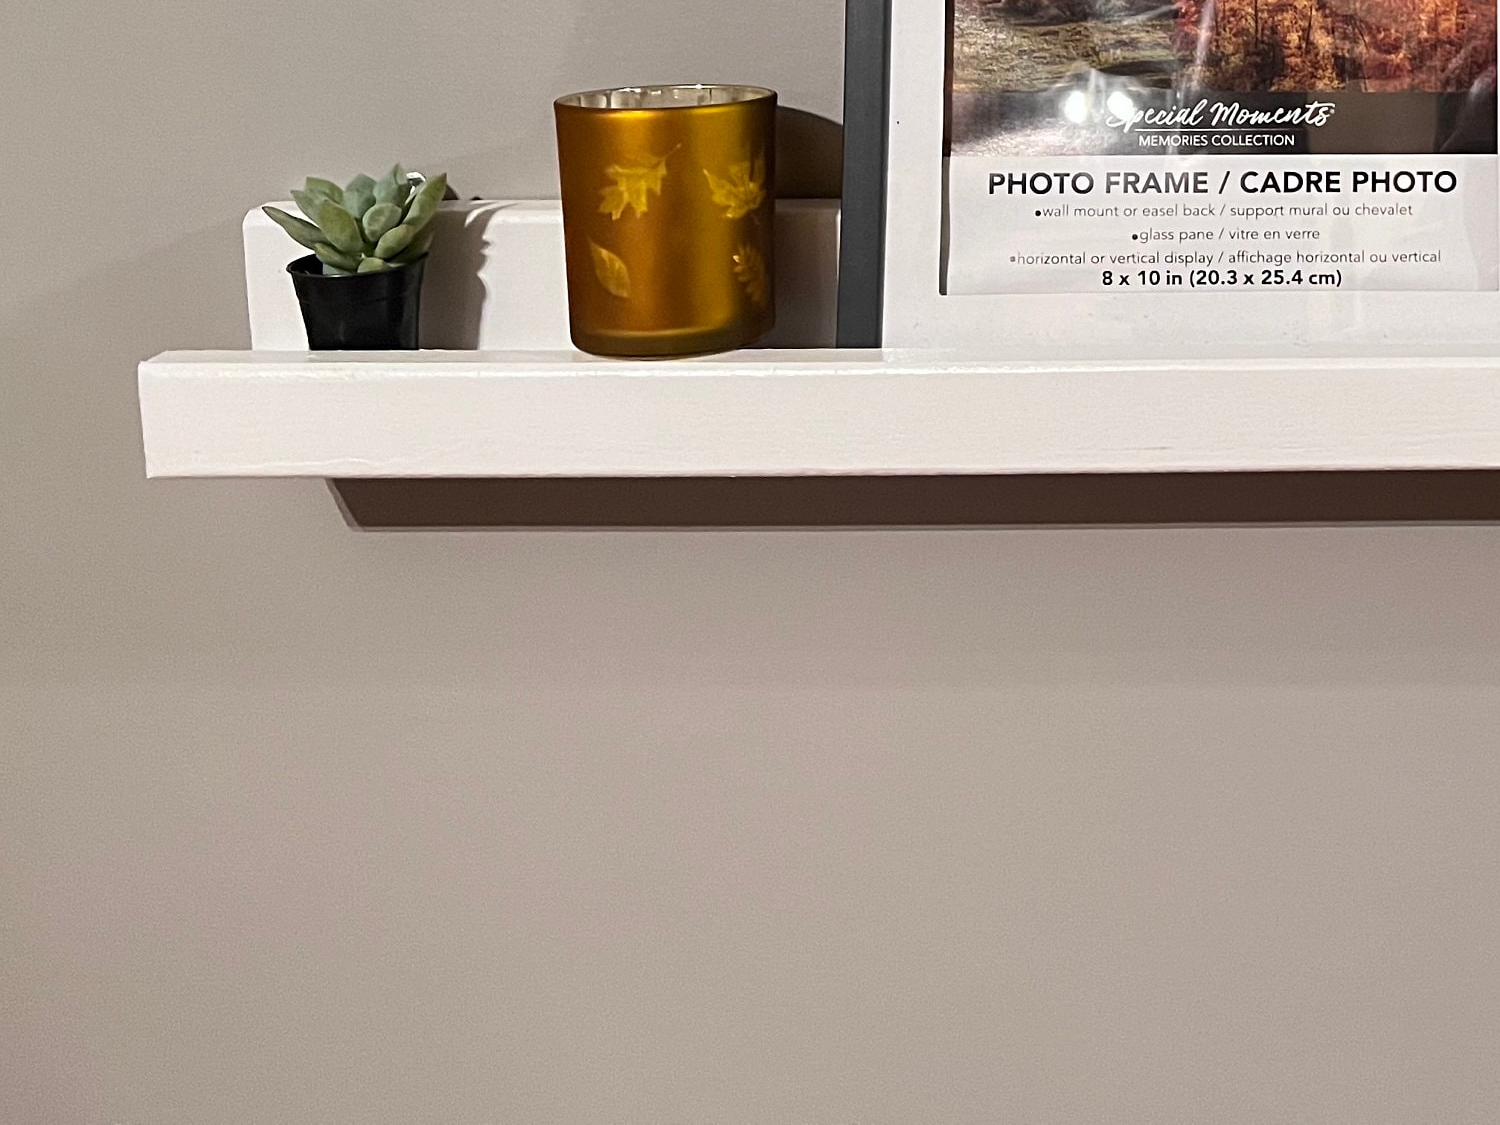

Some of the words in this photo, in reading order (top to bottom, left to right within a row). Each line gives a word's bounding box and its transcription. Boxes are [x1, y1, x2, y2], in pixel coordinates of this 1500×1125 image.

[1210, 100, 1334, 127] Moments
[1139, 134, 1208, 147] MEMORIES
[1212, 134, 1295, 146] COLLECTION
[988, 172, 1095, 195] PHOTO
[1105, 172, 1208, 195] FRAME
[1218, 171, 1231, 194] /
[1239, 171, 1341, 194] CADRE
[1352, 170, 1457, 193] PHOTO
[1042, 205, 1070, 217] wall
[1074, 206, 1120, 217] mount
[1123, 208, 1138, 217] or
[1142, 204, 1179, 217] easel
[1183, 204, 1216, 216] back
[1218, 204, 1227, 216] /
[1230, 204, 1285, 221] support
[1288, 204, 1328, 216] mural
[1332, 206, 1350, 216] ou
[1354, 203, 1413, 216] chevalet
[1139, 228, 1175, 244] glass
[1178, 230, 1214, 245] pane
[1217, 228, 1225, 240] /
[1227, 228, 1260, 240] vitre
[1263, 231, 1283, 240] en
[1286, 230, 1320, 240] verre
[1017, 251, 1086, 265] horizontal
[1090, 253, 1106, 264] or
[1109, 251, 1160, 264] vertical
[1164, 250, 1215, 267] display
[1217, 250, 1225, 264] /
[1228, 250, 1293, 267] affichage
[1296, 250, 1366, 263] horizontal
[1369, 252, 1388, 263] ou
[1391, 250, 1441, 262] vertical
[1102, 271, 1113, 286] 8
[1119, 274, 1130, 286] x
[1137, 270, 1161, 286] 10
[1166, 270, 1183, 286] in
[1188, 268, 1238, 289] (20.3
[1243, 274, 1255, 285] x
[1261, 270, 1304, 285] 25.4
[1308, 268, 1342, 288] cm)
